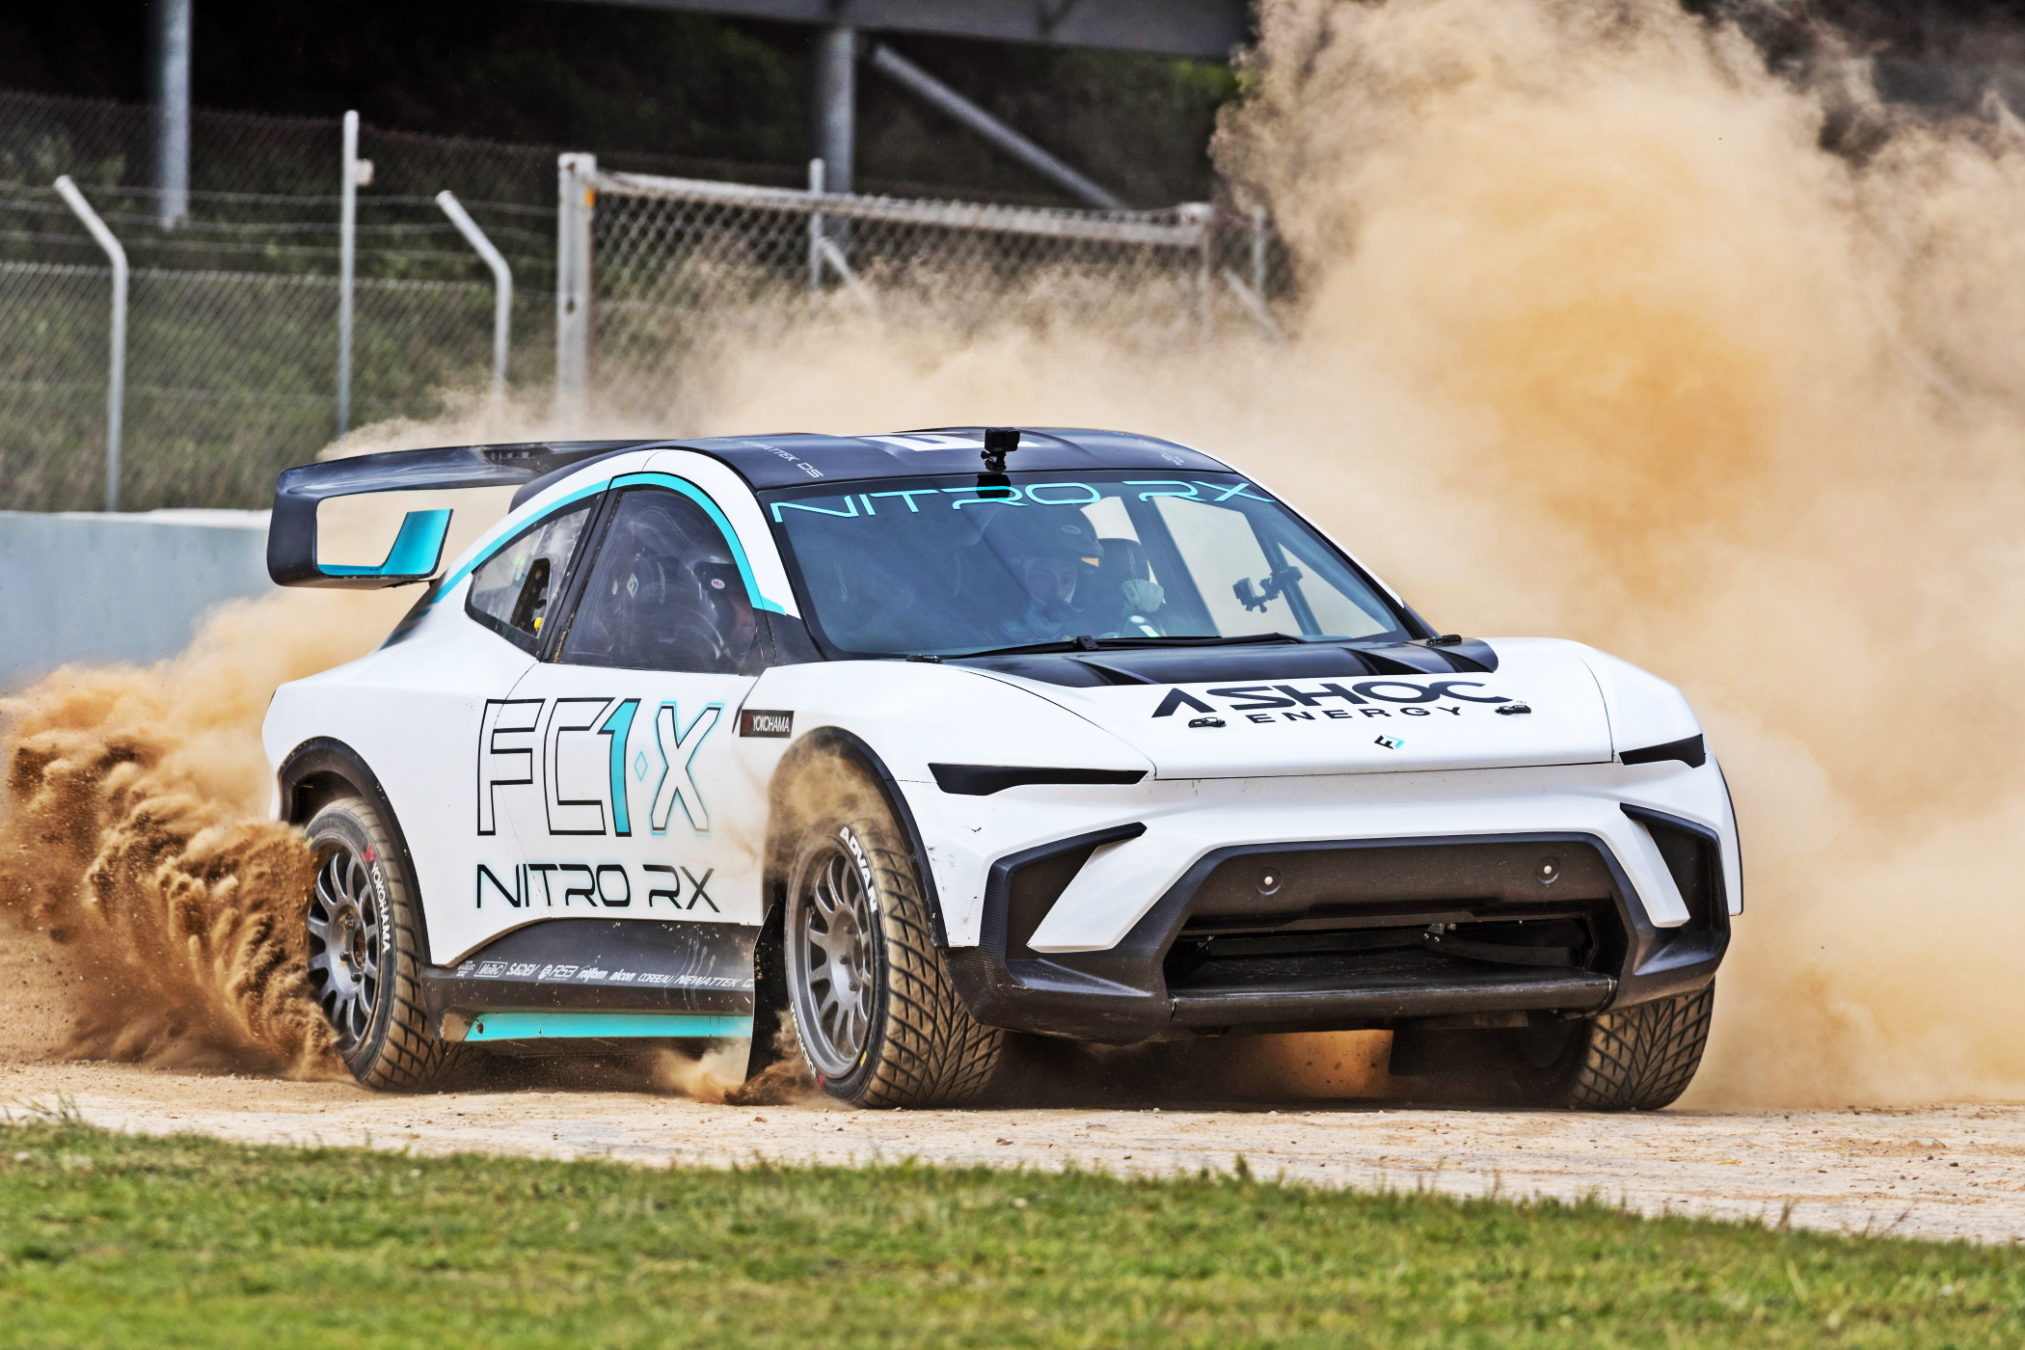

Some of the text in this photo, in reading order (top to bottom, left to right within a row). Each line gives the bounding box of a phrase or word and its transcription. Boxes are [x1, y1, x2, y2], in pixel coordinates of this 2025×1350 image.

[769, 479, 1278, 523] NITRO RX
[1151, 680, 1514, 719] ASHOC
[1245, 705, 1462, 725] ENERGY
[752, 714, 790, 733] YOKOHAMA
[476, 863, 721, 913] NITRO RX
[839, 826, 878, 914] ADVAN
[371, 861, 391, 953] YOKOHAMA
